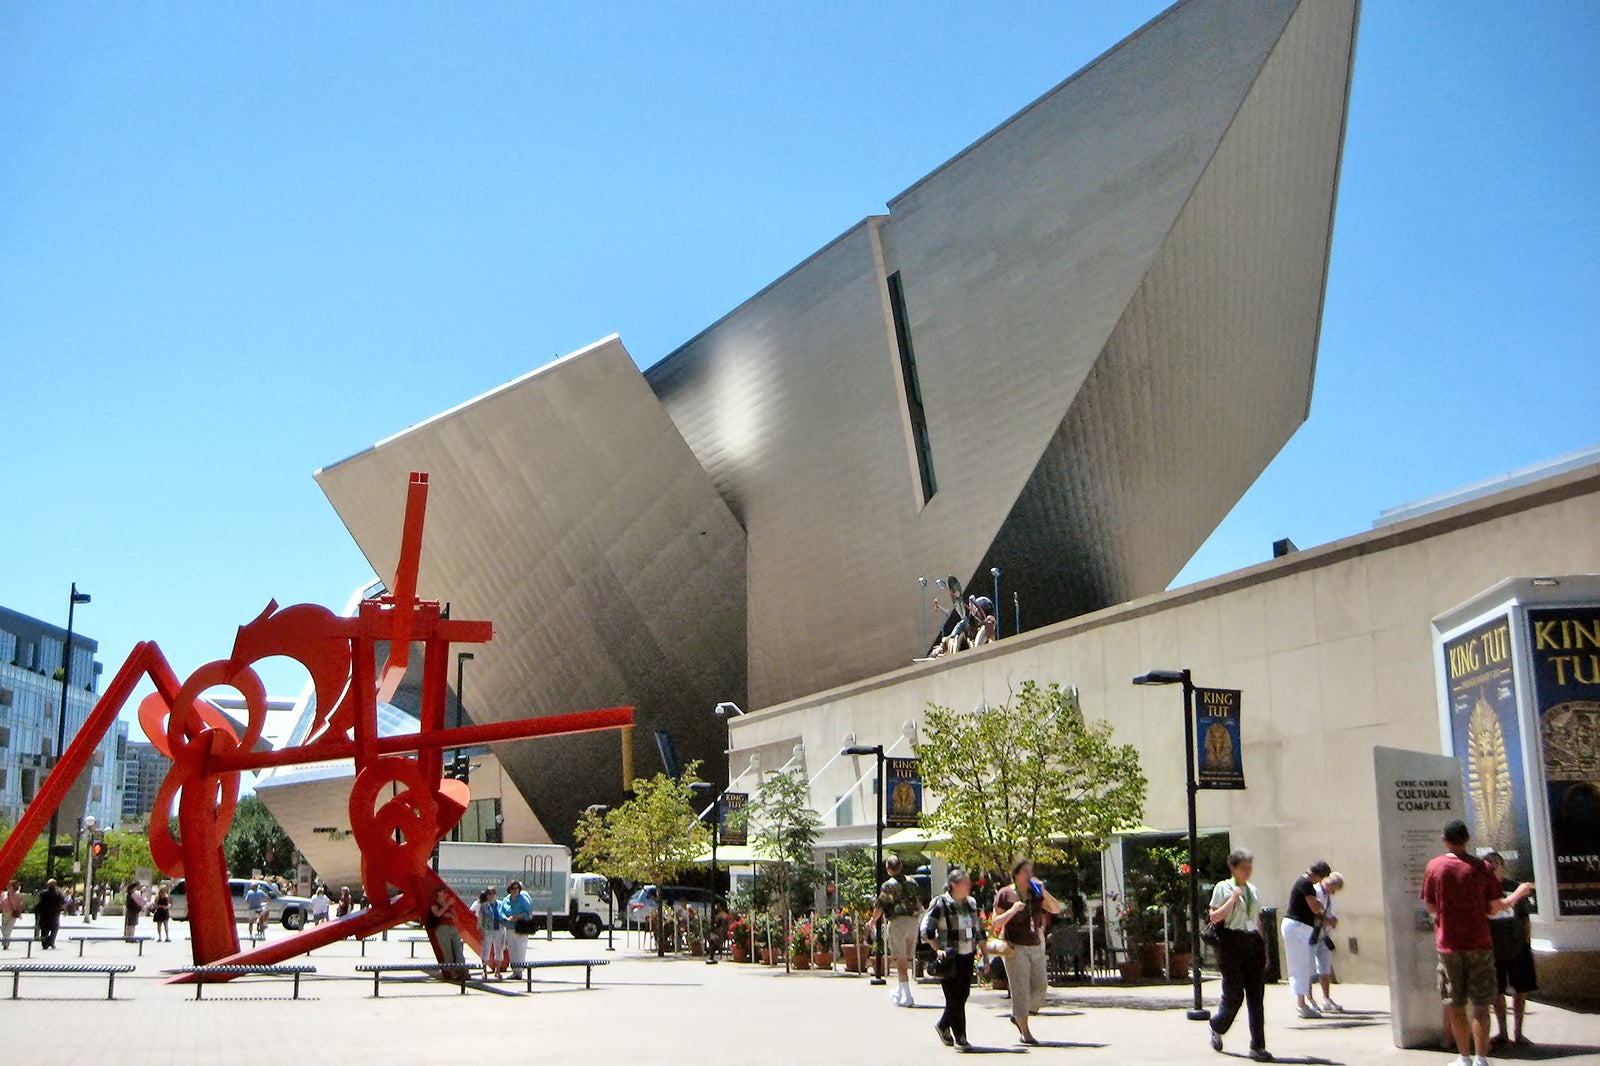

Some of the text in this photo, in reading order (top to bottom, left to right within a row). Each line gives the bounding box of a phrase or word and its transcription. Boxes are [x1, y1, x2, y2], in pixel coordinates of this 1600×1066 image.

[1450, 639, 1479, 679] KING
[1481, 626, 1507, 665] TUT
[1203, 692, 1233, 705] KING
[1207, 705, 1230, 717] TUT
[893, 760, 915, 769] KING
[895, 769, 913, 778] TUT
[1396, 789, 1451, 799] CULTURAL
[1397, 800, 1451, 811] COMPLEX
[1558, 854, 1600, 864] DENVER
